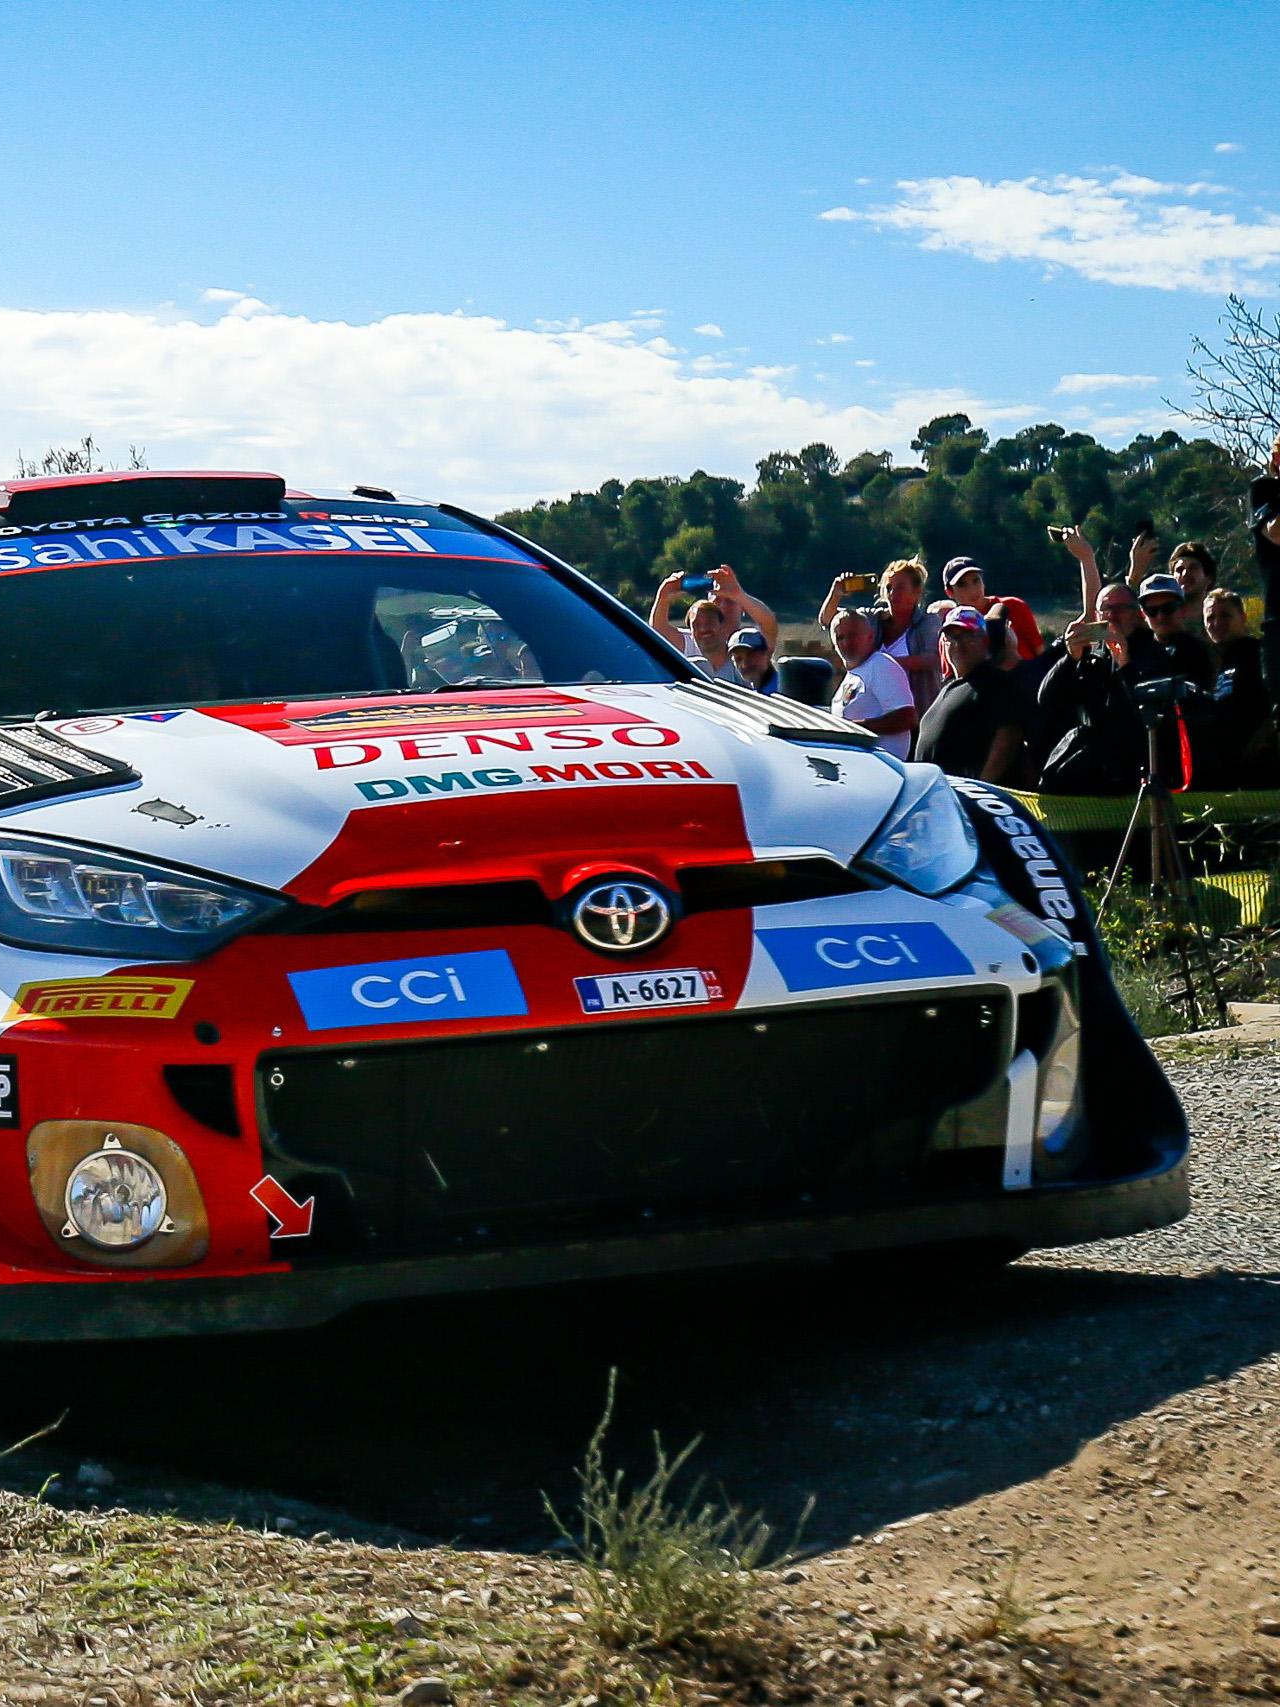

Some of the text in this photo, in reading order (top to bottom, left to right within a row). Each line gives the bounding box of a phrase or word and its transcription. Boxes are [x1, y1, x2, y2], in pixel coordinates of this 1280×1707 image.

[142, 511, 288, 523] GAZOO
[297, 511, 430, 527] Racing
[308, 726, 681, 770] DENSO
[16, 982, 177, 1014] PIRELLI
[611, 975, 697, 1005] A-6627
